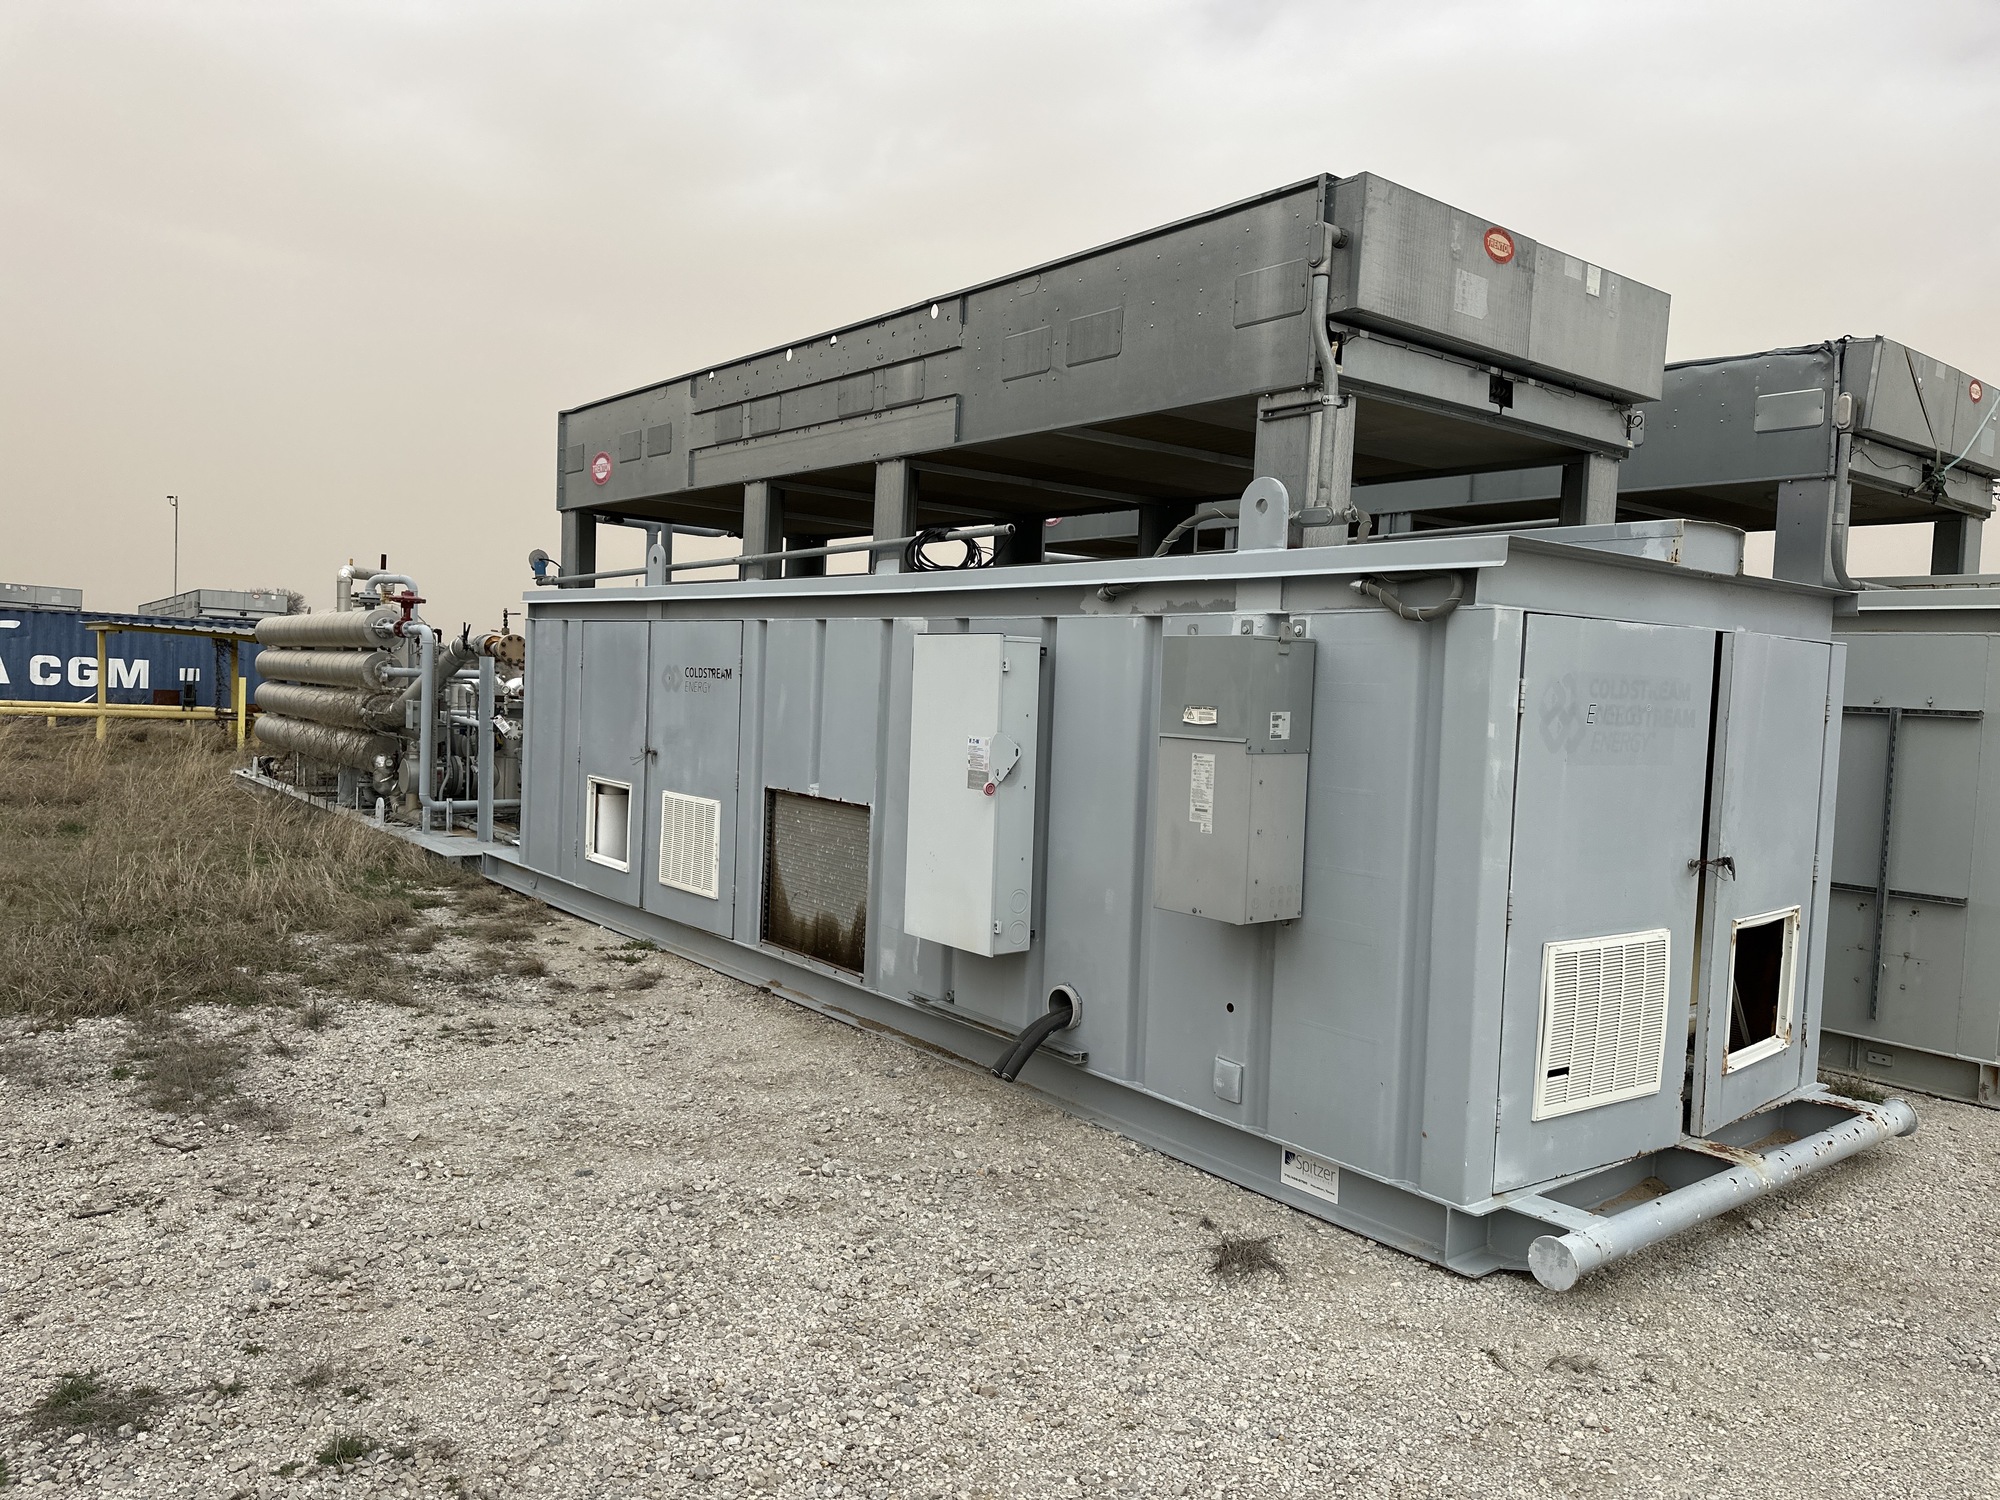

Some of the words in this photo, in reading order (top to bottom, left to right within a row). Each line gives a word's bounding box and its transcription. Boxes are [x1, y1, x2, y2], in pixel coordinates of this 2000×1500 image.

[29, 654, 150, 690] CGM
[684, 667, 733, 680] COLDSTREAM
[684, 680, 712, 694] ENERGY
[1295, 1154, 1337, 1182] Spitzer
